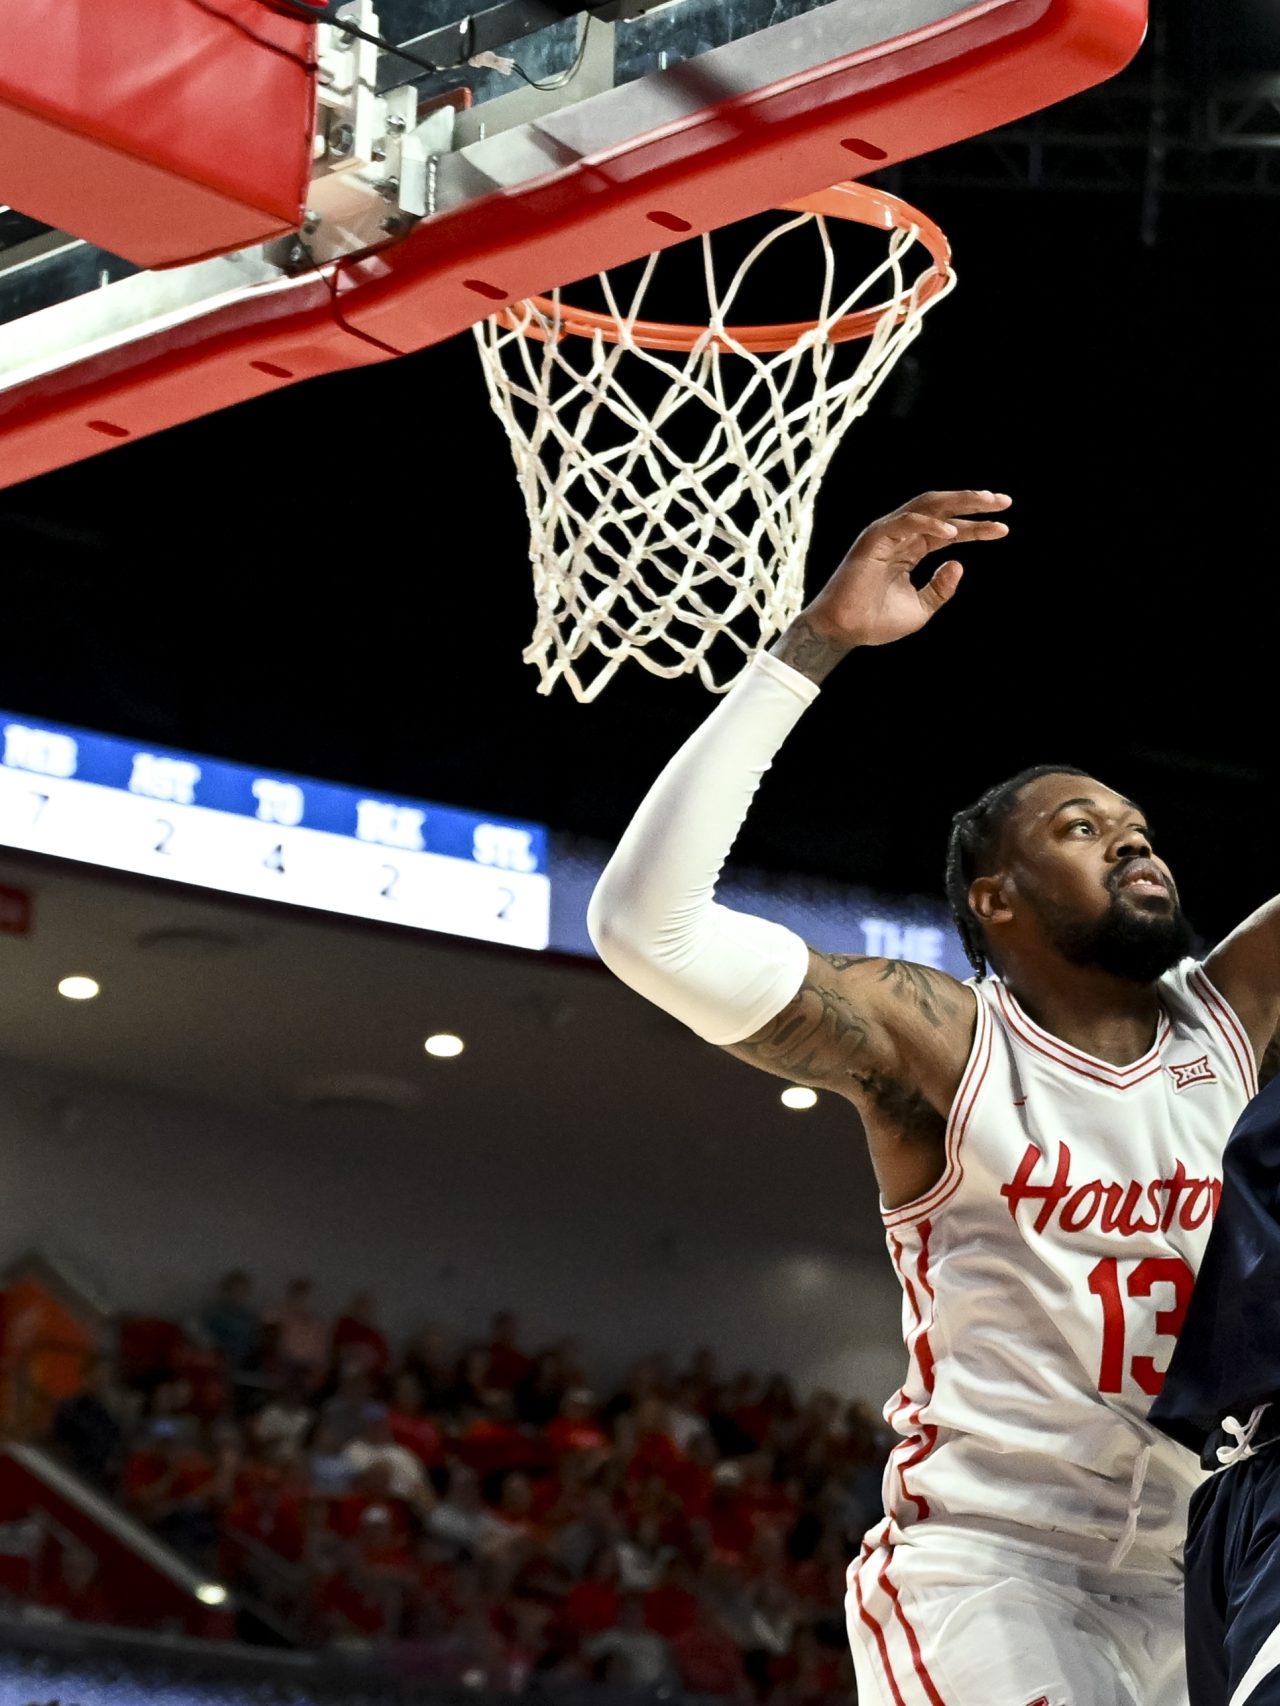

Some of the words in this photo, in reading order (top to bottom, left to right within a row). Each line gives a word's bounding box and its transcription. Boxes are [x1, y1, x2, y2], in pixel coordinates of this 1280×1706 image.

[29, 790, 50, 826] 7
[153, 818, 175, 856] 2
[261, 843, 286, 875] 4
[379, 864, 400, 899] 2
[495, 886, 516, 922] 2
[1088, 1256, 1196, 1396] 13
